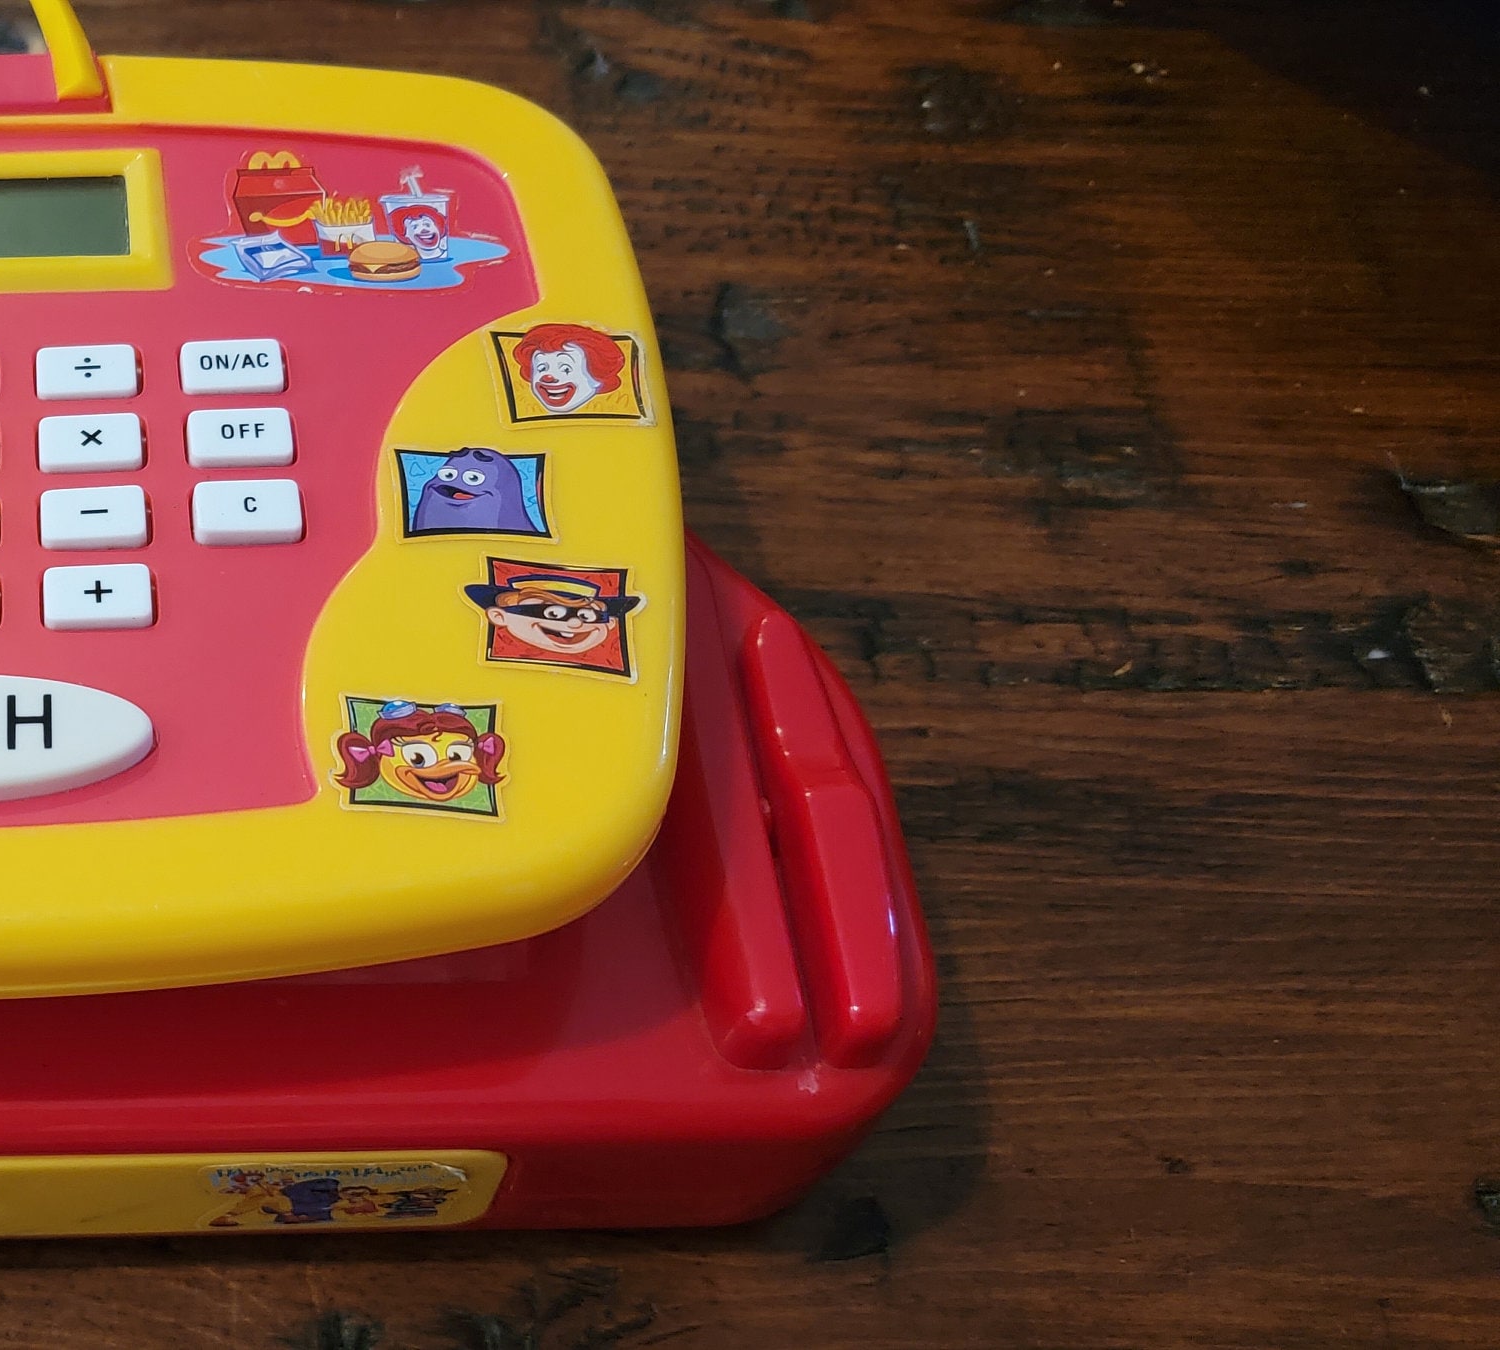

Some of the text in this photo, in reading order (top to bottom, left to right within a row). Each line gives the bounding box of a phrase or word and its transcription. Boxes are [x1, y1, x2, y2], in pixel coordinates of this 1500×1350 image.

[199, 352, 269, 371] ON/AC
[220, 422, 265, 440] OFF
[243, 496, 258, 513] C
